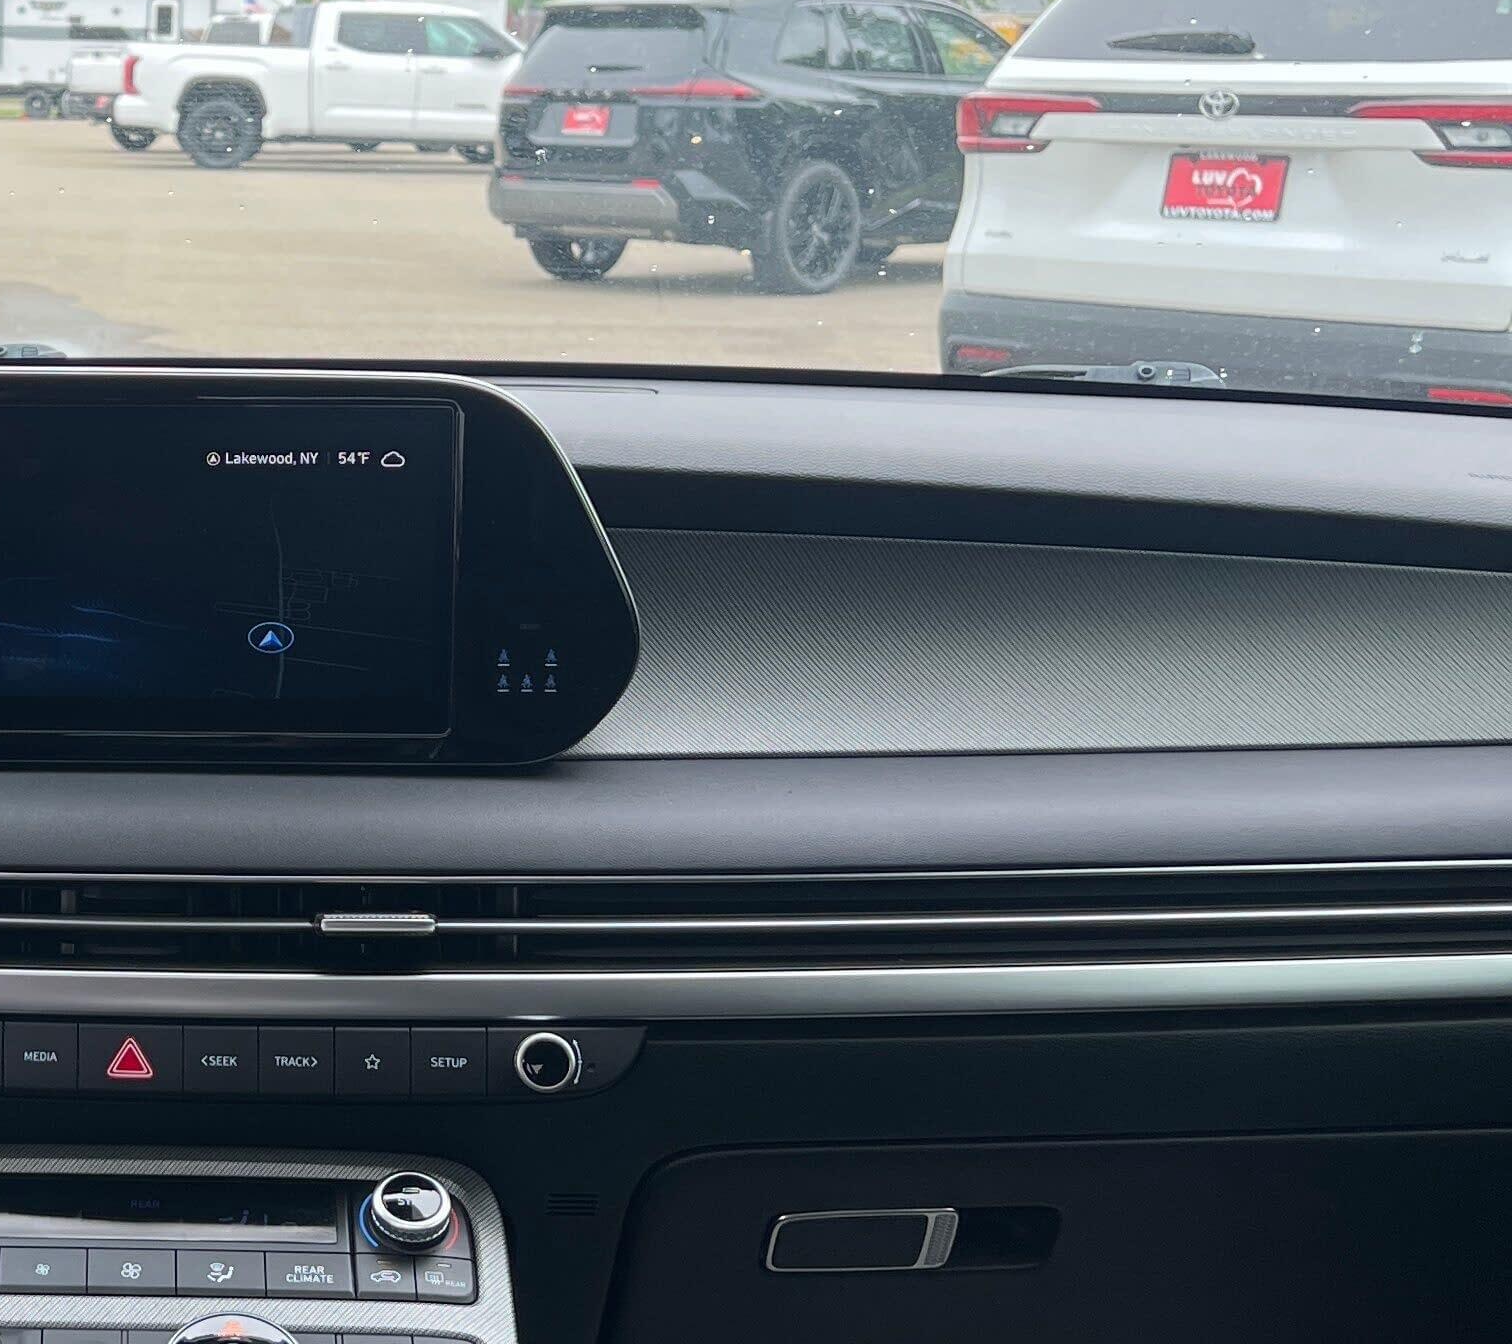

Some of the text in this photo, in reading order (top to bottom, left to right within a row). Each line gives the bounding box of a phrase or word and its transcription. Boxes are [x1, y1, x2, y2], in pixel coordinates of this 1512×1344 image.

[1192, 169, 1227, 186] LUV
[225, 451, 297, 466] Lakewood,
[300, 451, 319, 465] NY
[23, 1050, 58, 1062] MEDIA
[430, 1056, 468, 1068] SETUP
[294, 1265, 325, 1274] REAR
[286, 1273, 334, 1284] CLIMATE
[445, 1280, 466, 1288] REAR
